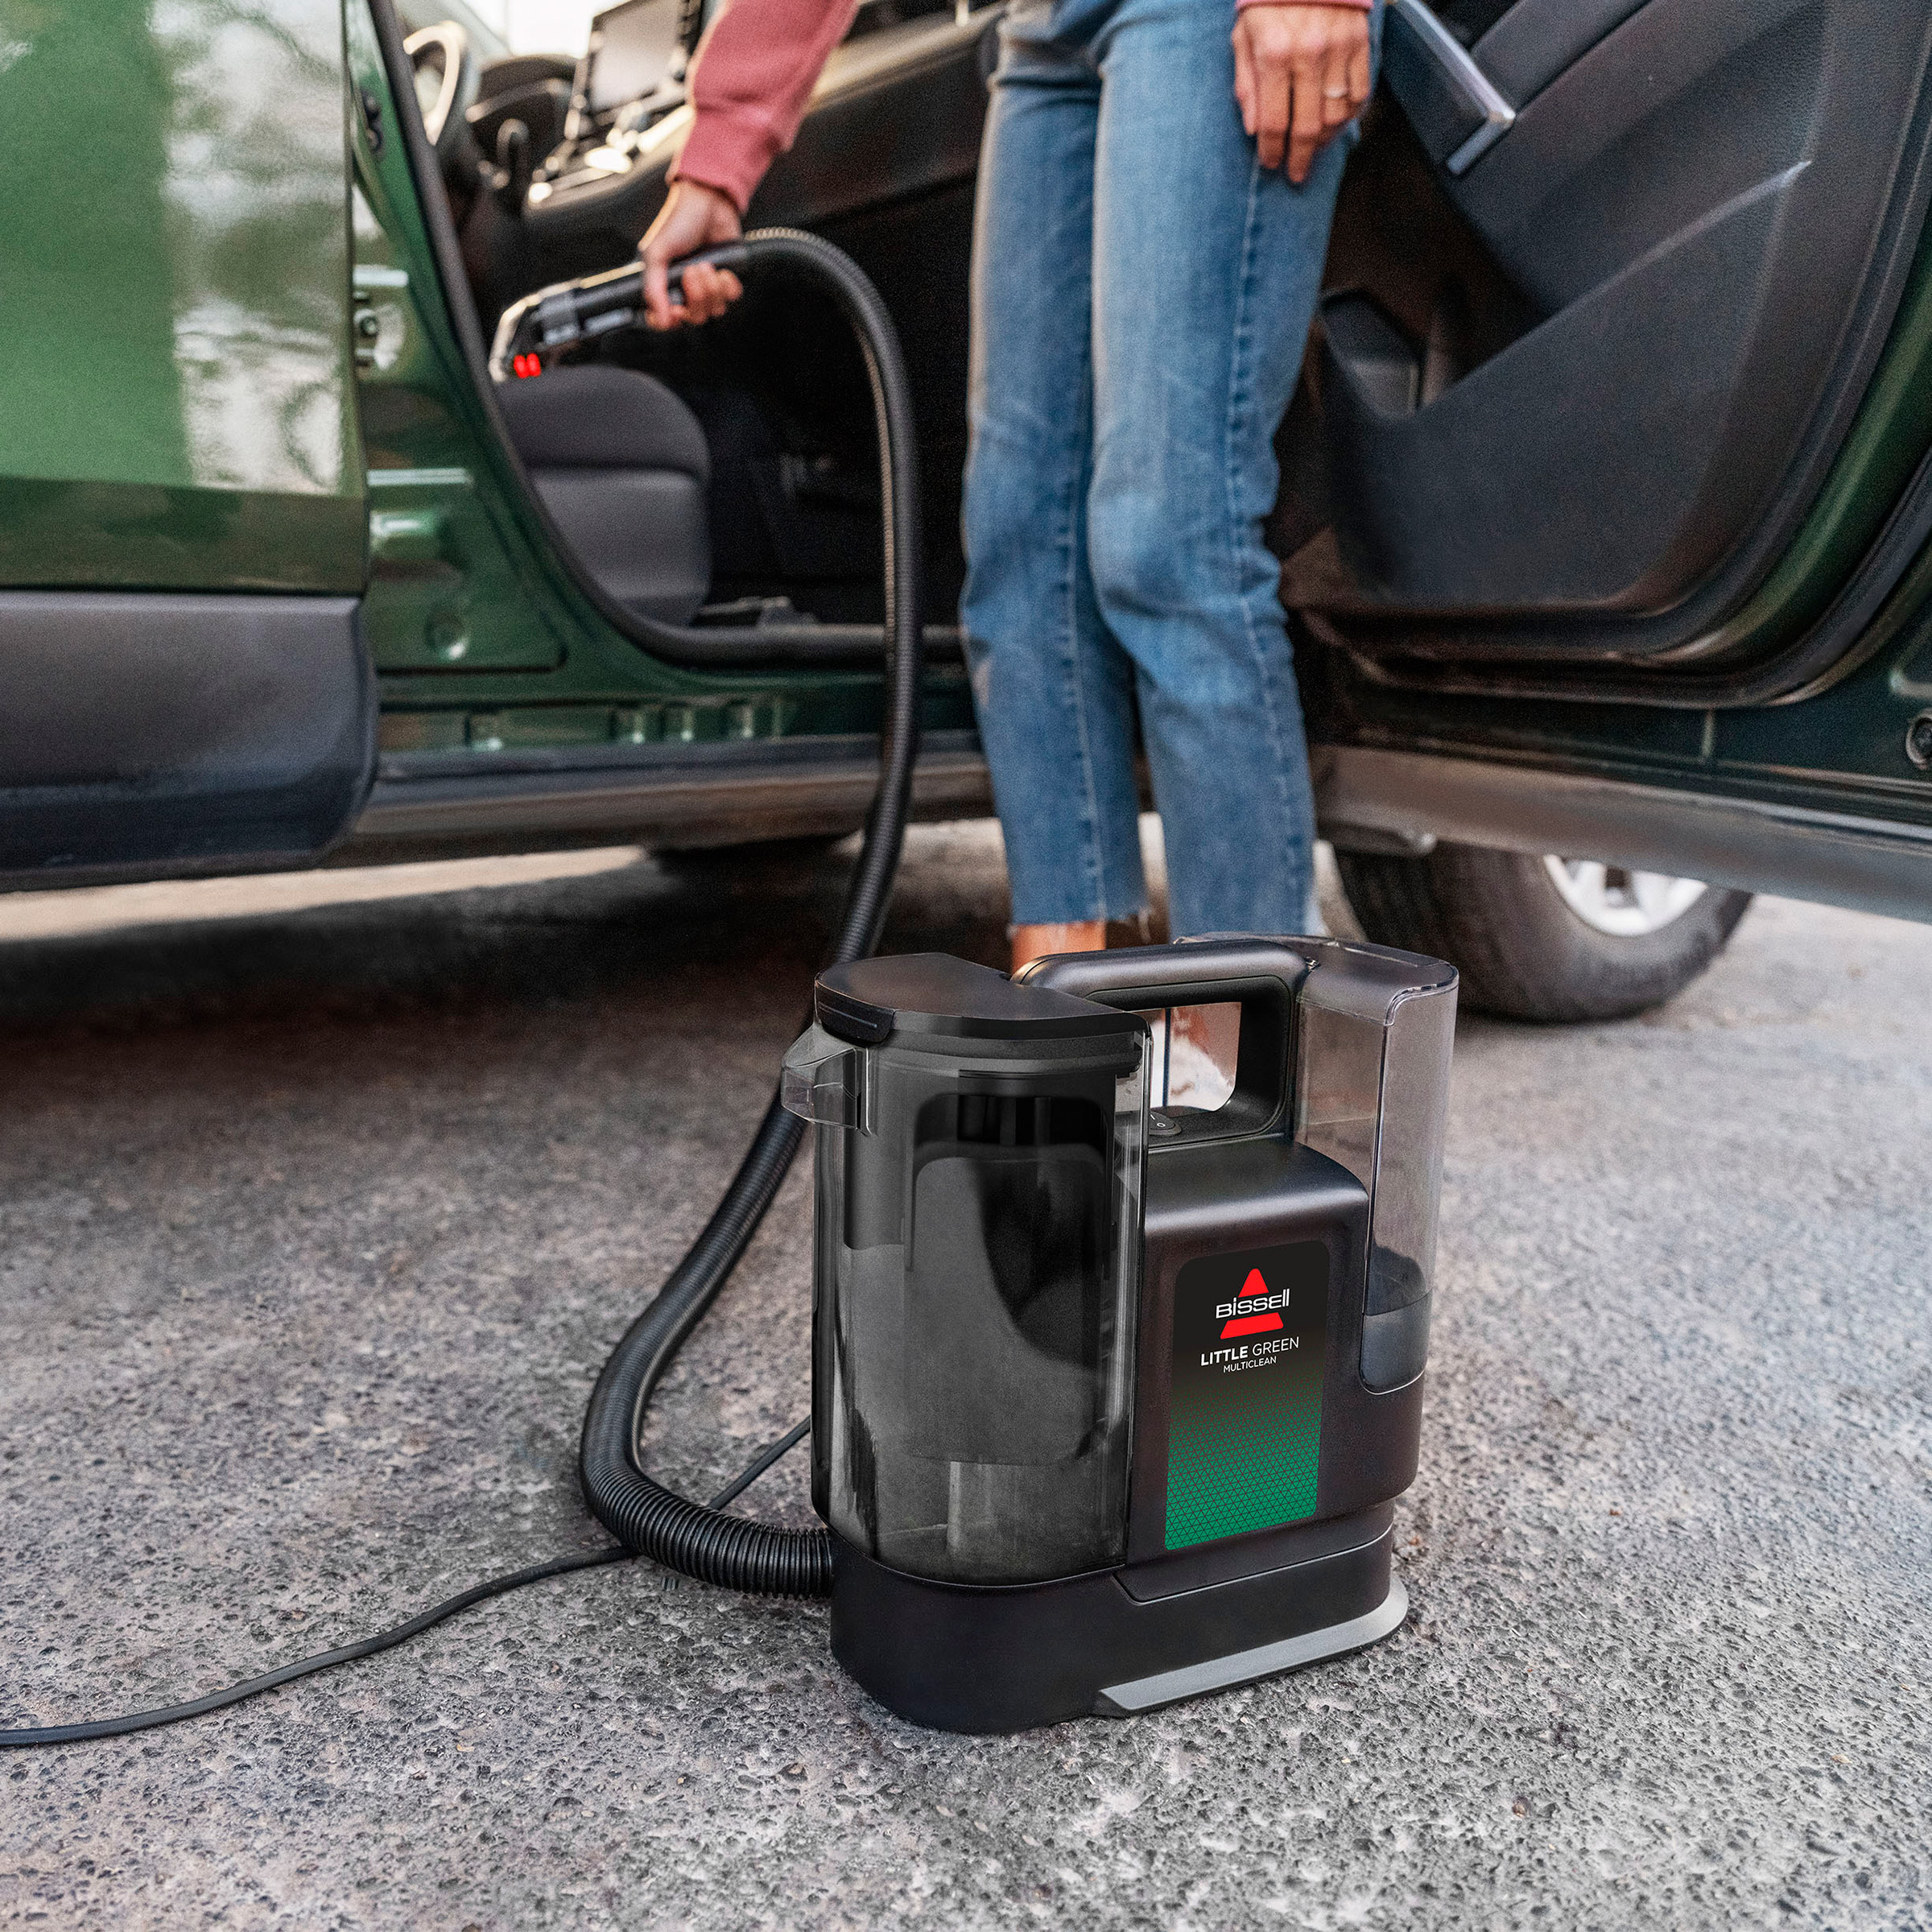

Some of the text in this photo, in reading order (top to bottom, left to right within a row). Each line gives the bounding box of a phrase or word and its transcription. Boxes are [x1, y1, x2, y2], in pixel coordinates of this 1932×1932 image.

[1200, 1336, 1300, 1366] LITTLE GREEN
[1223, 1356, 1278, 1373] MULTICLEAN
